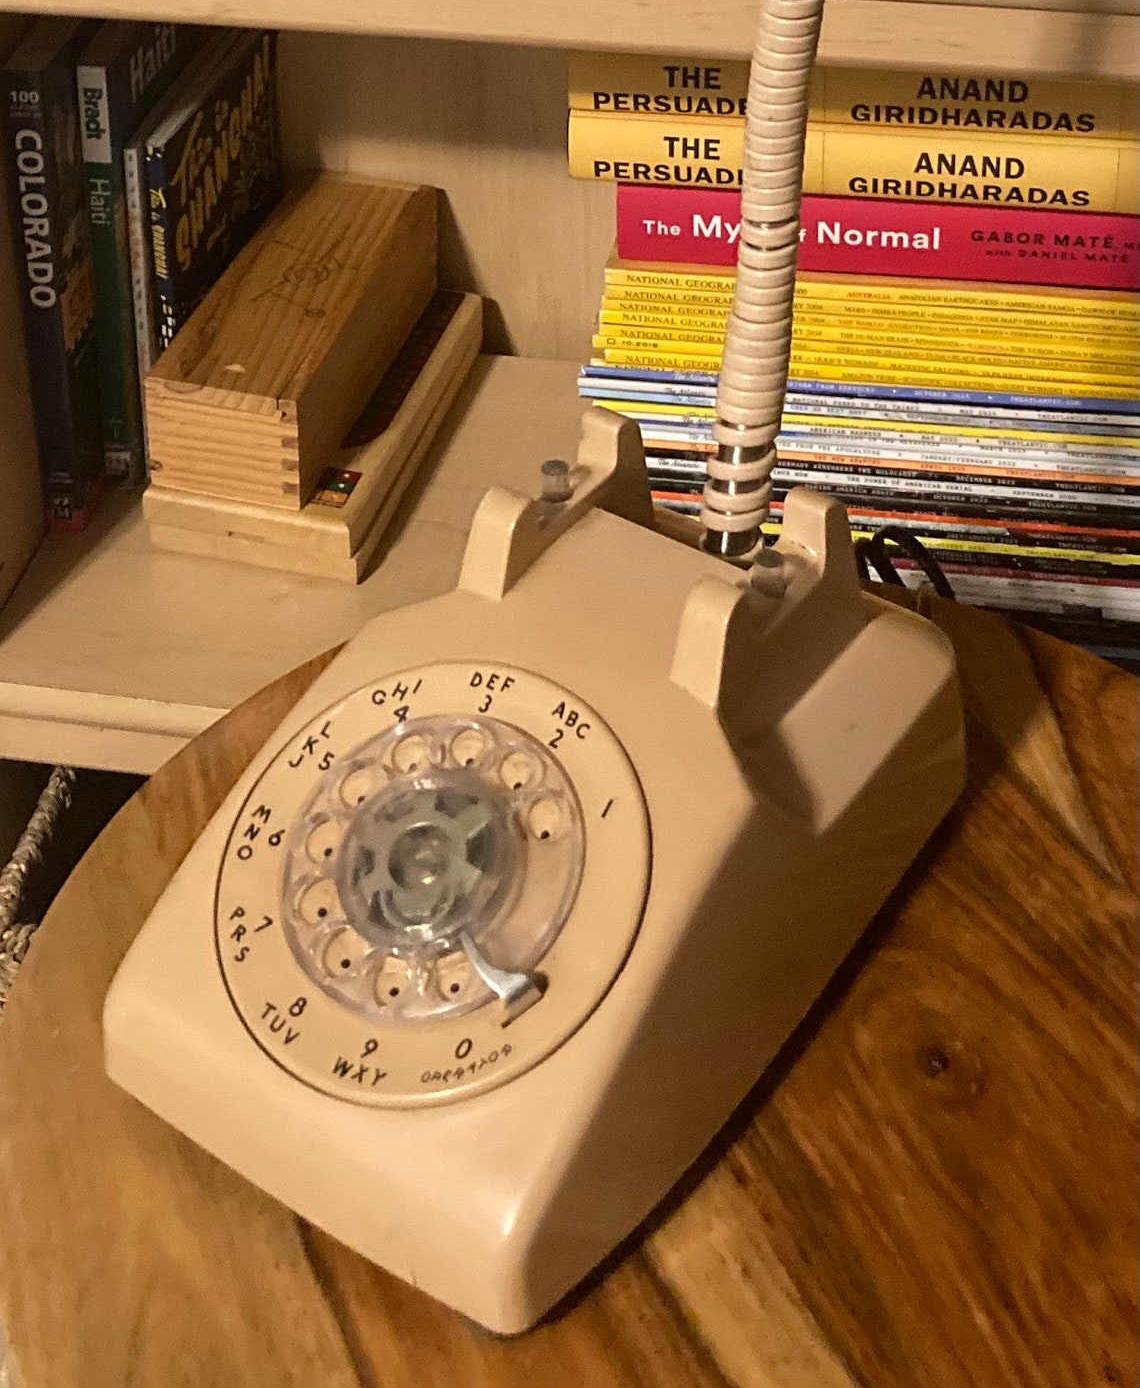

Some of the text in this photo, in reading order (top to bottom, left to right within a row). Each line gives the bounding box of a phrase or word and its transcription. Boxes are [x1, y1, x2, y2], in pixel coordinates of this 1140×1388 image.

[663, 65, 721, 90] THE
[10, 90, 39, 103] 100
[917, 77, 1028, 103] ANAND
[850, 103, 1095, 132] GIRIDHARADAS
[663, 135, 721, 160] THE
[593, 160, 743, 185] PERSUAD
[914, 152, 1025, 180] ANAND
[89, 178, 112, 225] Haiti
[848, 176, 1090, 206] GIRIDHARADAS
[15, 129, 56, 308] COLORADO
[642, 219, 681, 236] The
[692, 213, 741, 244] My
[817, 220, 940, 250] Normal
[971, 229, 1044, 245] GABOR
[1018, 249, 1077, 261] DANIEL
[626, 273, 681, 286] NATIONAL
[624, 289, 679, 302] NATIONAL
[619, 301, 673, 313] NATIONAL
[622, 313, 676, 326] NATIONAL
[620, 329, 675, 341] NATIONAL
[626, 354, 680, 367] NATIONAL
[683, 359, 720, 370] GEOGR
[658, 458, 670, 466] The
[470, 671, 515, 692] DEF
[371, 680, 422, 705] GHI
[393, 705, 410, 723] 4
[478, 694, 493, 713] 3
[552, 701, 591, 739] ABC
[288, 721, 332, 768] JKL
[548, 728, 564, 749] 2
[318, 752, 335, 771] 5
[601, 799, 614, 818] 1
[237, 804, 272, 860] MNO
[268, 829, 285, 847] 6
[229, 906, 250, 962] PRS
[254, 915, 274, 933] 7
[289, 996, 307, 1017] 8
[261, 1001, 300, 1045] TUV
[361, 1038, 379, 1059] 9
[455, 1038, 473, 1060] 0
[333, 1056, 387, 1087] WXY
